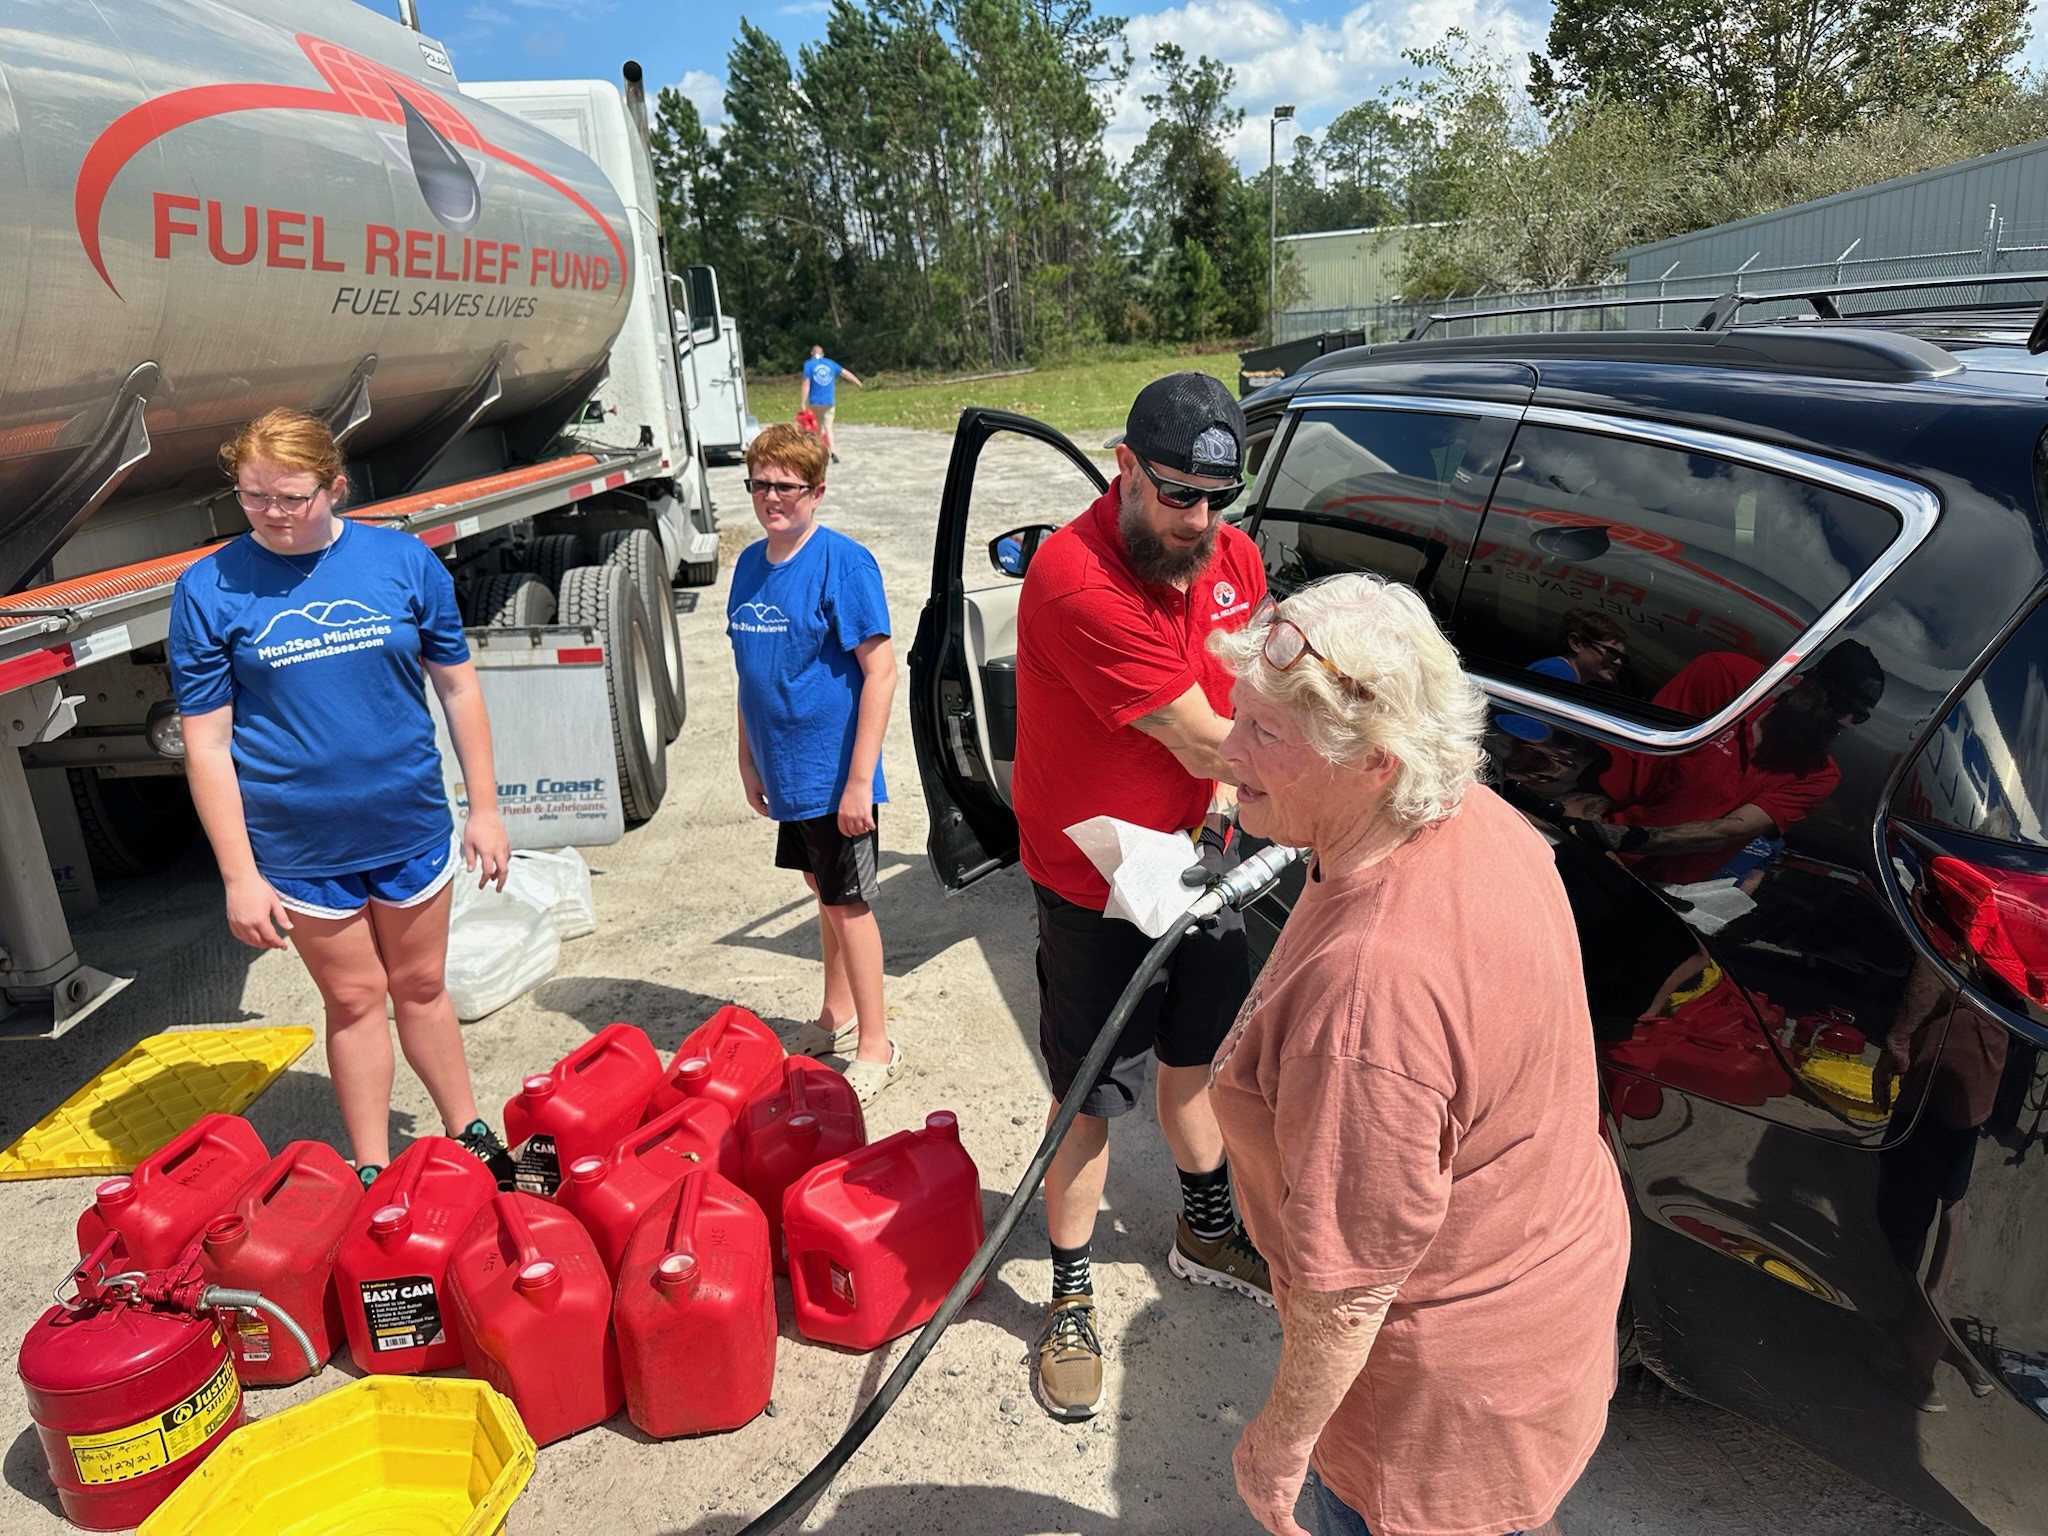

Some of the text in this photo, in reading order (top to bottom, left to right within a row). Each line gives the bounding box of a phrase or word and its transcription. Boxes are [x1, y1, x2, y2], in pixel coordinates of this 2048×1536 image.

[153, 192, 610, 291] FUEL RELIEF FUND
[331, 287, 538, 318] FUEL SAVES LIVES
[258, 624, 392, 660] Mtn2Sea Ministries
[270, 638, 384, 669] www.mtn2sea.com
[496, 778, 605, 796] un Coast
[502, 804, 532, 815] Fuels
[534, 804, 541, 813] &
[532, 1142, 556, 1155] CAN
[362, 1283, 434, 1303] EASY CAN
[206, 1389, 228, 1415] SAFETY
